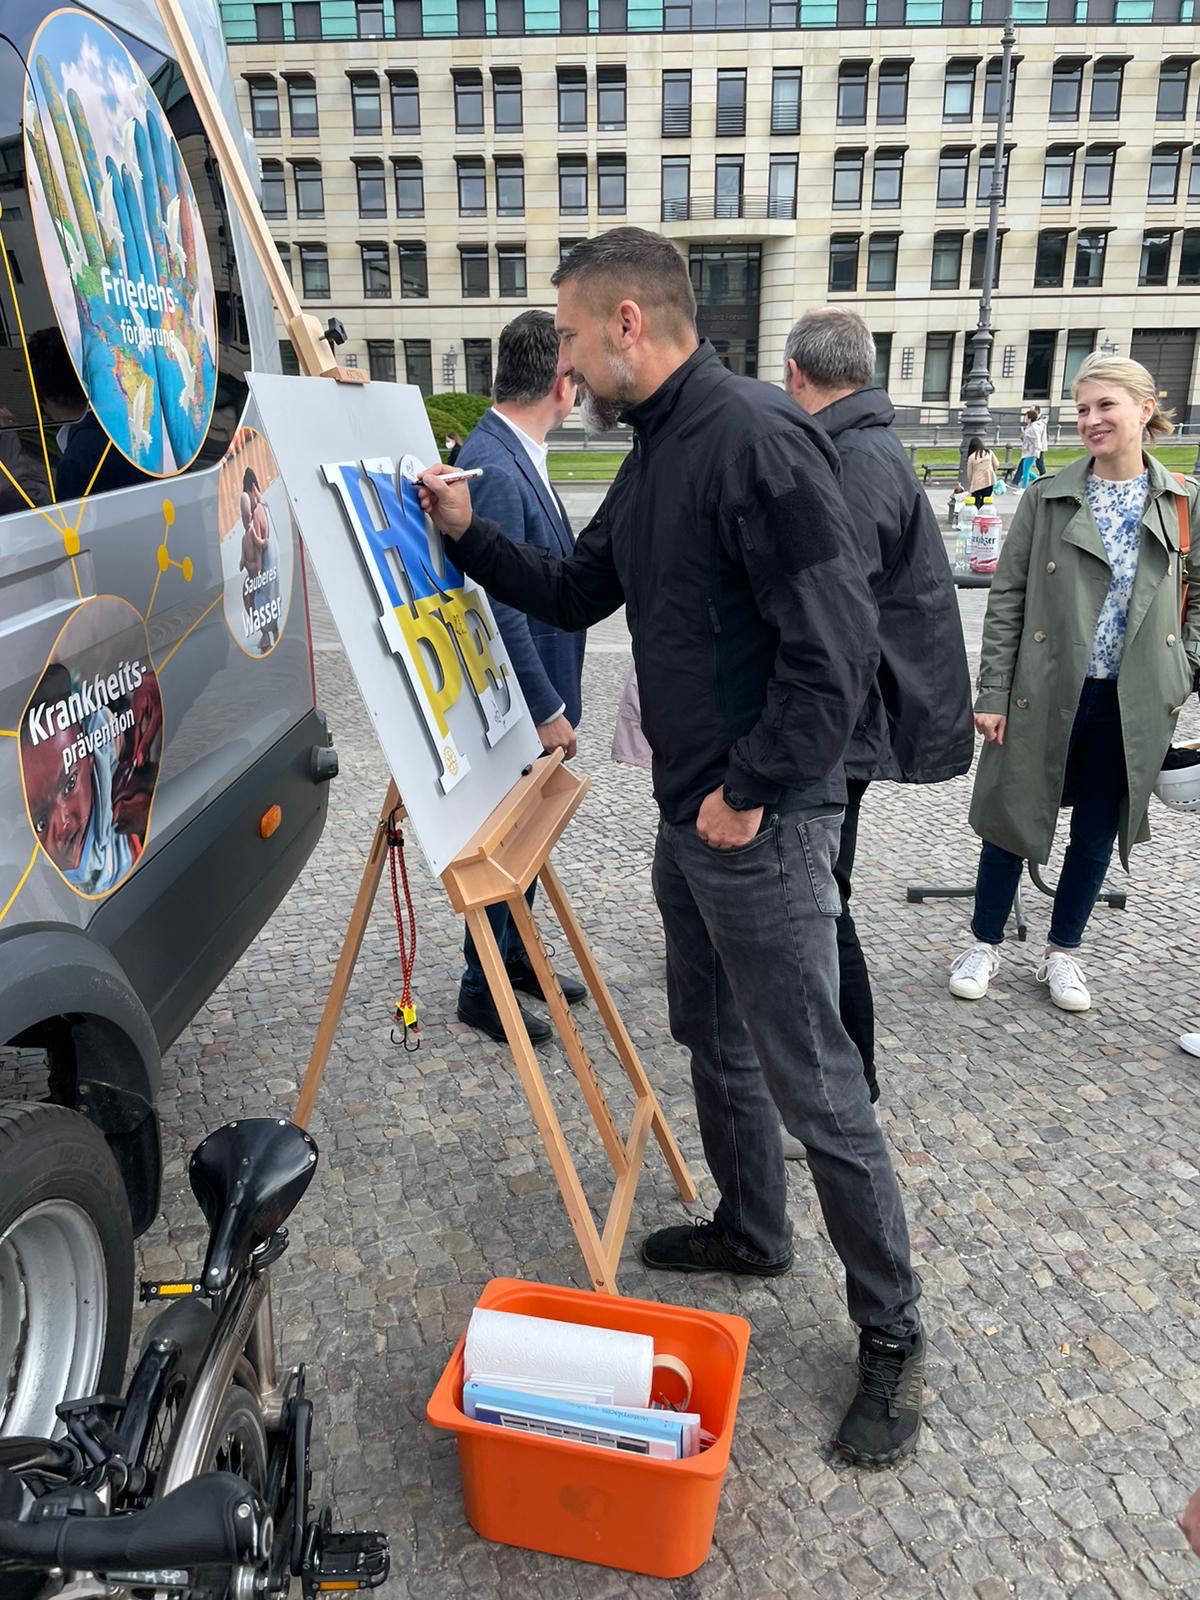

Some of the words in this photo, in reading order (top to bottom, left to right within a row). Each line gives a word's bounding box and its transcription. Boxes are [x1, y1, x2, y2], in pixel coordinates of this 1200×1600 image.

[101, 267, 179, 314] Friedens-
[121, 318, 176, 351] förderung
[244, 566, 278, 596] Sauberes
[241, 596, 282, 638] Wasser
[28, 660, 147, 746] Krankheits-
[62, 708, 136, 774] prävention
